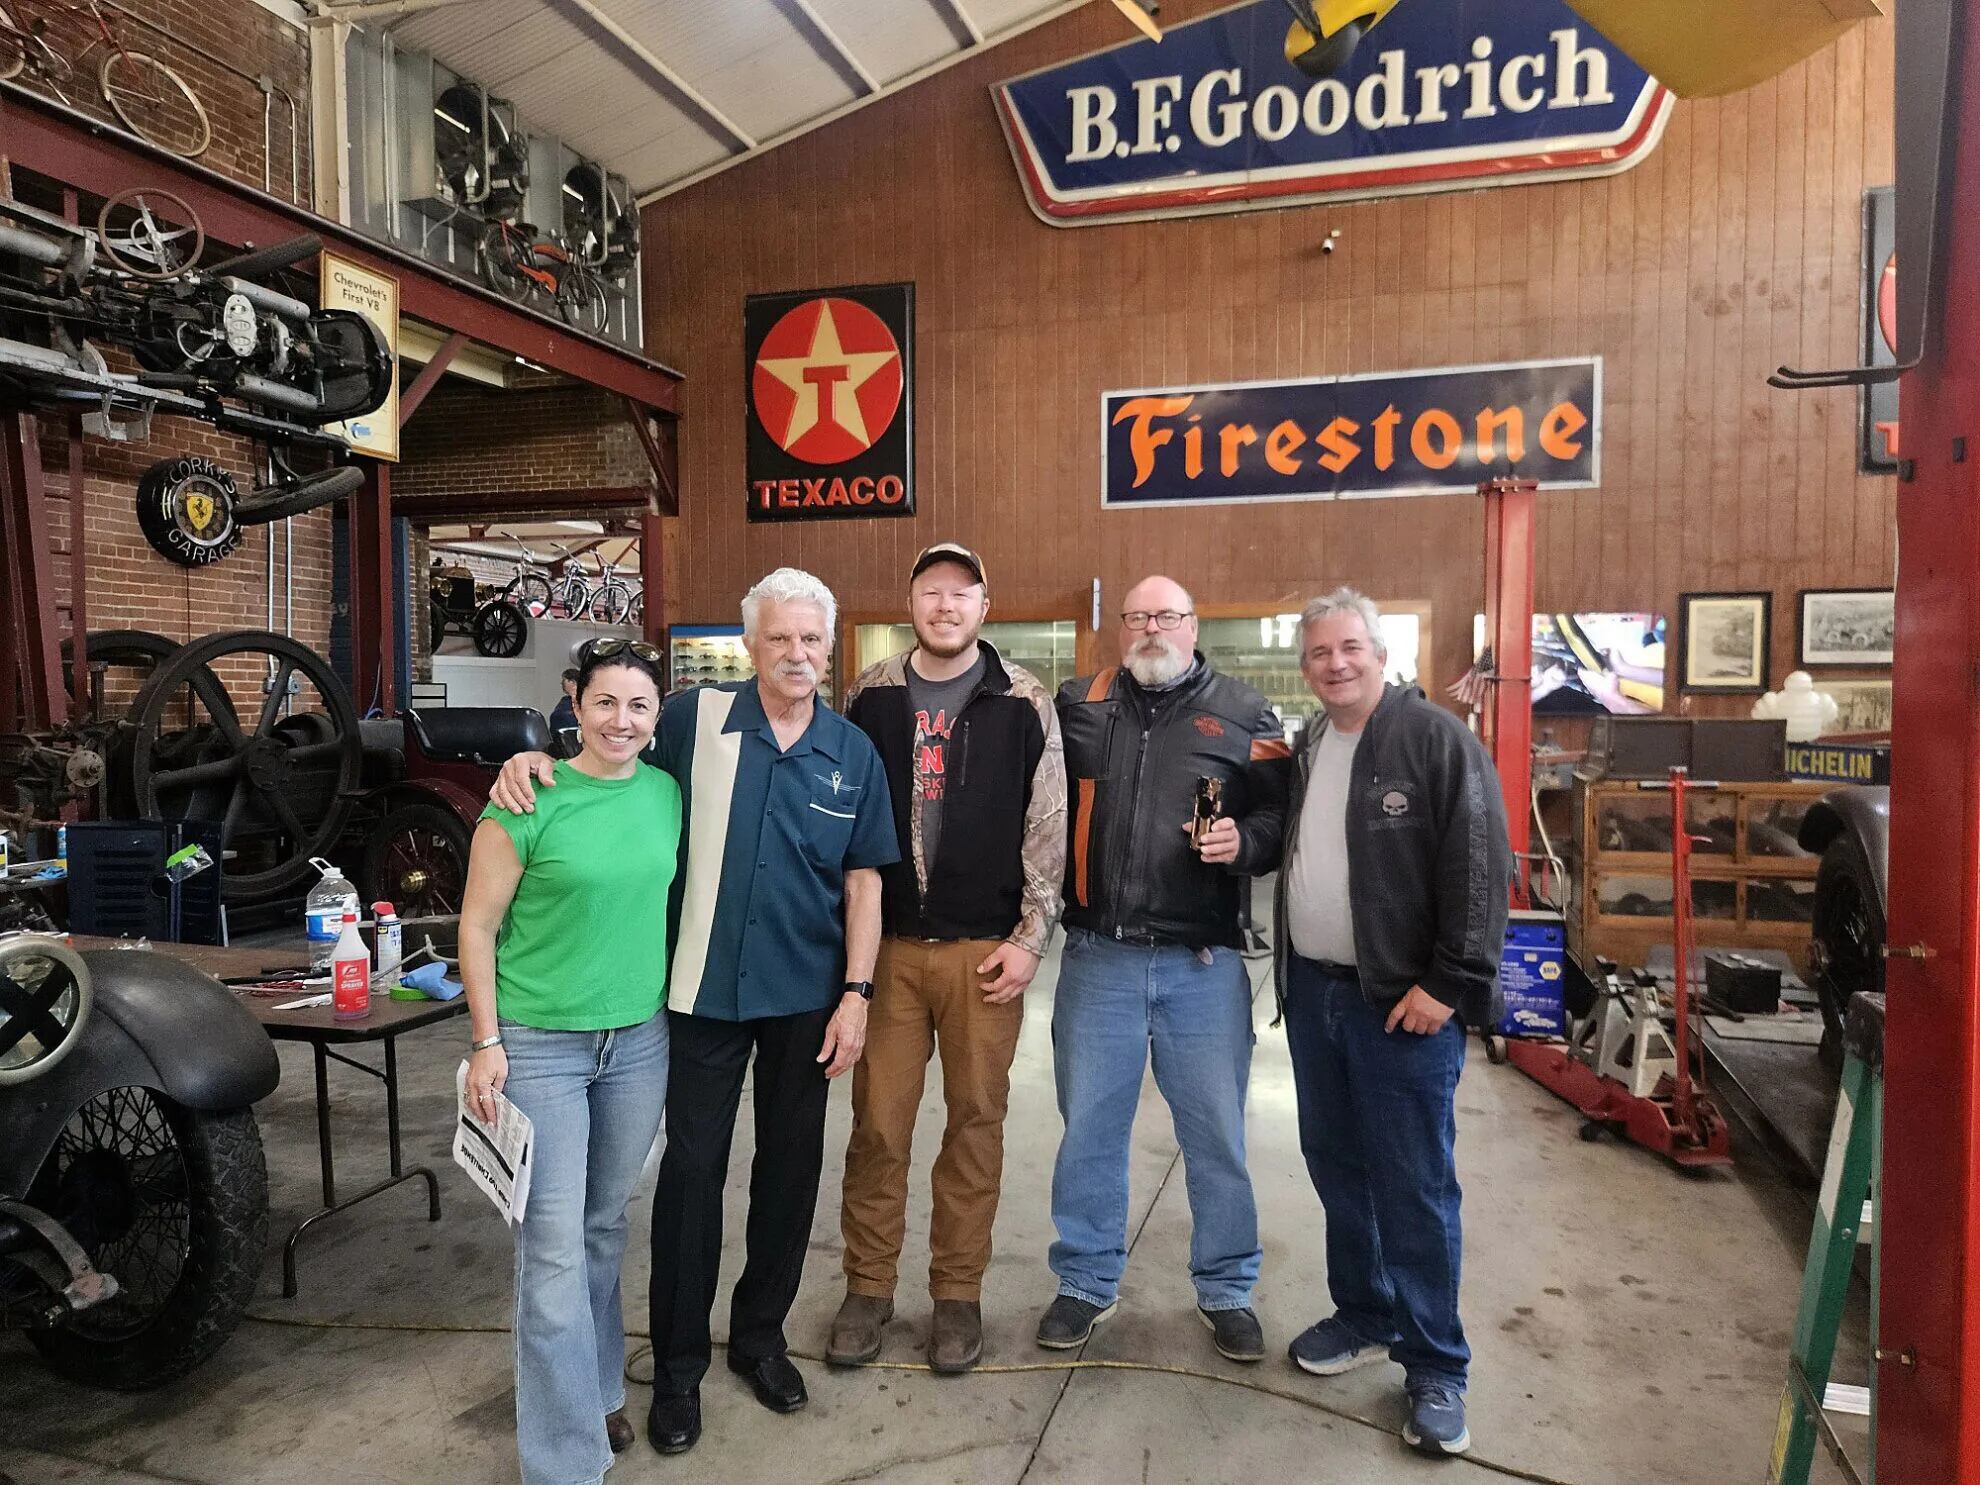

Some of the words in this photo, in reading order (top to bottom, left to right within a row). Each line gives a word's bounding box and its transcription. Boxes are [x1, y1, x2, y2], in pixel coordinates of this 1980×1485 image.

[333, 272, 387, 302] Chevrolet's
[342, 288, 363, 306] First
[366, 297, 380, 312] V8
[1112, 394, 1587, 488] Firestone
[753, 475, 904, 510] TEXACO
[1785, 750, 1871, 779] ICHELIN
